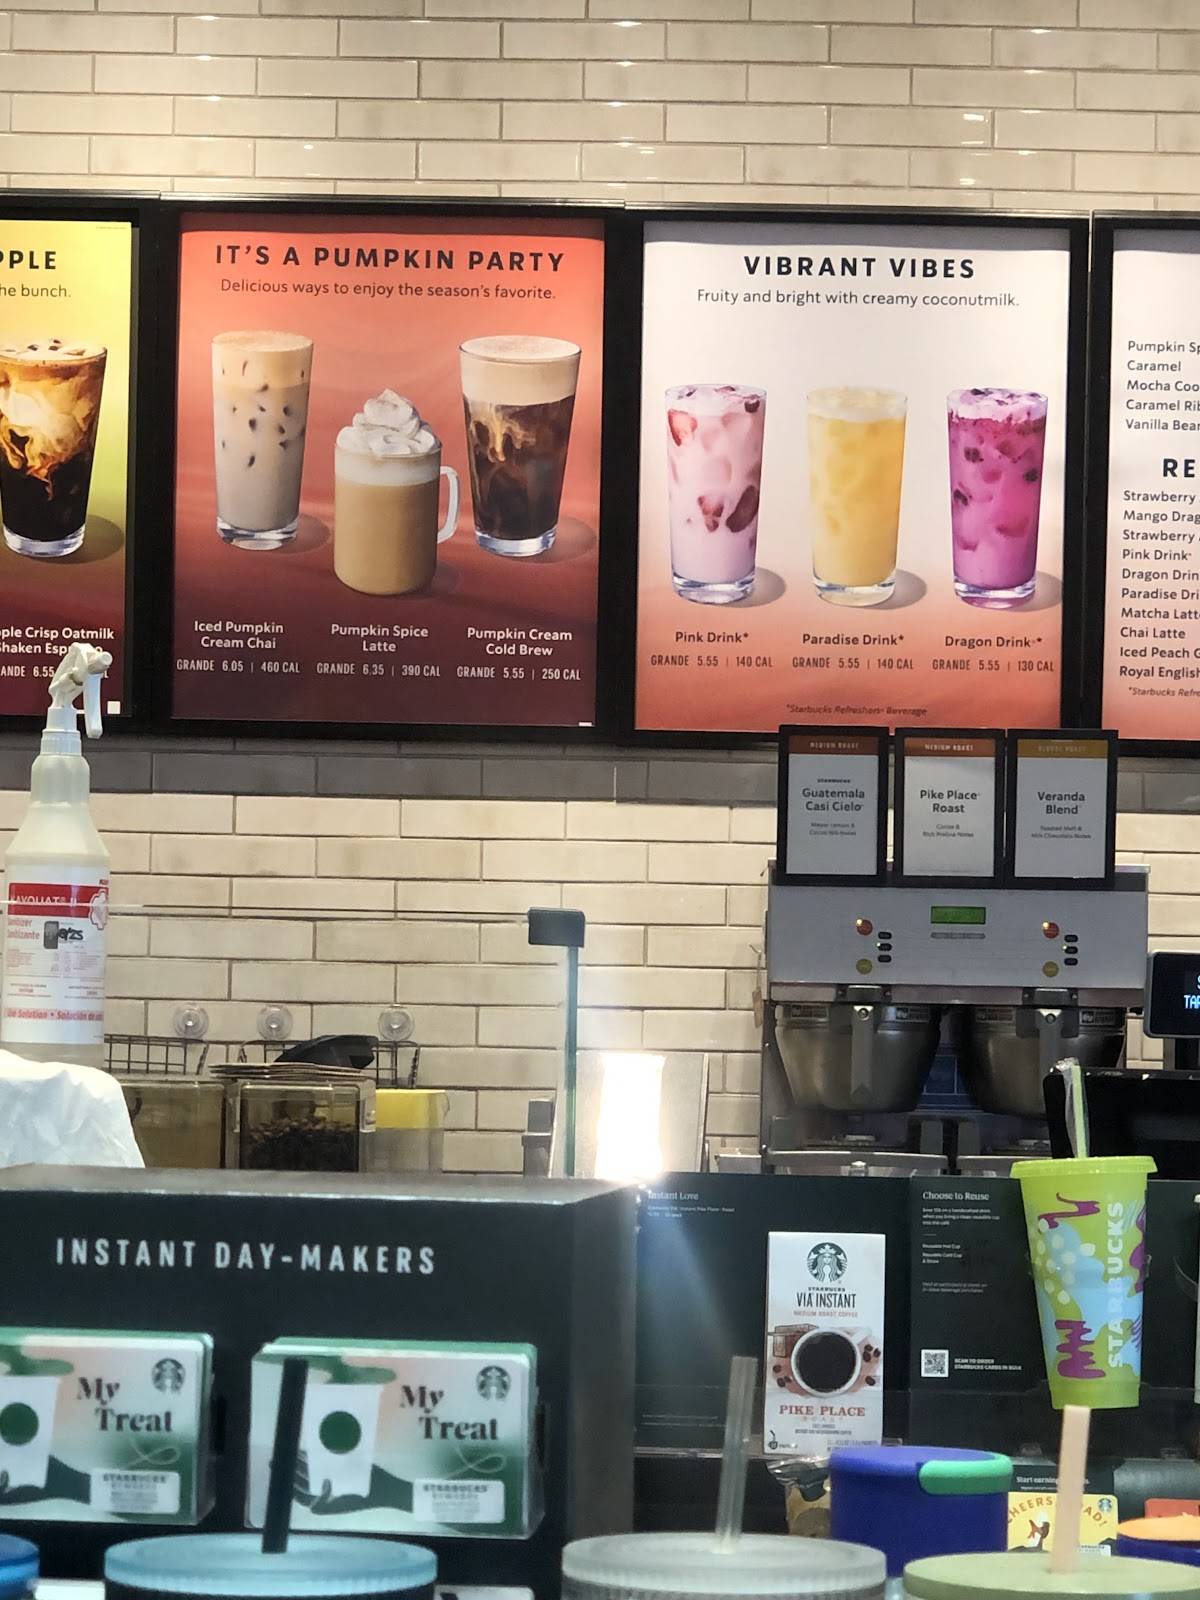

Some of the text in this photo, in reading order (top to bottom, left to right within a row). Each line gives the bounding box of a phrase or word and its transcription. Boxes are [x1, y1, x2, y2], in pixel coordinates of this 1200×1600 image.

[0, 250, 57, 269] PLE
[216, 245, 564, 272] IT'S A PUMPKIN PARTY
[743, 256, 974, 279] VIBRANT VIBES
[21, 284, 72, 298] bunch.
[221, 278, 556, 299] Delicious ways to enjoy the season's favorite.
[697, 289, 1020, 308] Fruity and bright with creamy coconutmilk.
[1127, 340, 1185, 354] Pumpkin
[1127, 360, 1181, 371] Caramel
[1126, 380, 1171, 391] Mocha
[1126, 399, 1180, 411] Caramel
[1125, 419, 1169, 430] Vanilla
[1162, 457, 1196, 478] RE
[1123, 490, 1196, 505] Strawberry
[1123, 510, 1168, 524] Mango
[1122, 529, 1195, 544] Strawberry
[1122, 548, 1150, 560] Pink
[1121, 568, 1168, 582] Dragon
[1121, 587, 1178, 600] Paradise
[1120, 607, 1170, 619] Matcha
[0, 626, 115, 640] ple Crisp Oatmilk
[194, 620, 284, 636] Iced Pumpkin
[331, 624, 429, 639] Pumpkin Spice
[467, 627, 573, 641] Pumpkin Cream
[1120, 626, 1186, 639] Chai Latte
[201, 636, 276, 649] Cream Chai
[675, 631, 703, 643] Pink
[802, 633, 859, 645] Paradise
[945, 635, 992, 649] Dragon
[362, 640, 397, 652] Latte
[485, 643, 553, 656] Cold Brew
[1119, 646, 1147, 657] Iced
[1151, 647, 1190, 658] Peach
[176, 658, 300, 673] GRANDE 6.05 460 CAL
[650, 654, 773, 668] GRANDE 5.55 140 CAL
[792, 656, 914, 670] GRANDE 5.55 140 CAL
[932, 659, 1055, 672] GRANDE 5.55 130 CAL
[33, 666, 55, 678] 6.55
[316, 662, 441, 677] GRANDE 6.35 390 CAL
[456, 666, 581, 681] GRANDE 5.55 250 CAL
[1119, 665, 1154, 679] Royal
[801, 788, 865, 799] Guatemala
[920, 789, 978, 800] Pike Place
[1037, 791, 1086, 801] Veranda
[805, 801, 830, 812] Casi
[932, 803, 965, 813] Roast
[1045, 804, 1079, 815] Blend
[648, 1191, 699, 1200] Instant Love
[922, 1191, 990, 1201] Choose to Reuse
[56, 1238, 435, 1275] INSTANT DAY-MAKERS
[1107, 1202, 1124, 1368] STARBUCKS
[796, 1292, 857, 1309] VIA INSTANT
[77, 1377, 120, 1405] My
[400, 1385, 445, 1413] My
[779, 1405, 865, 1417] PIKE PLACE
[95, 1408, 173, 1432] Treat
[419, 1416, 498, 1440] Treat
